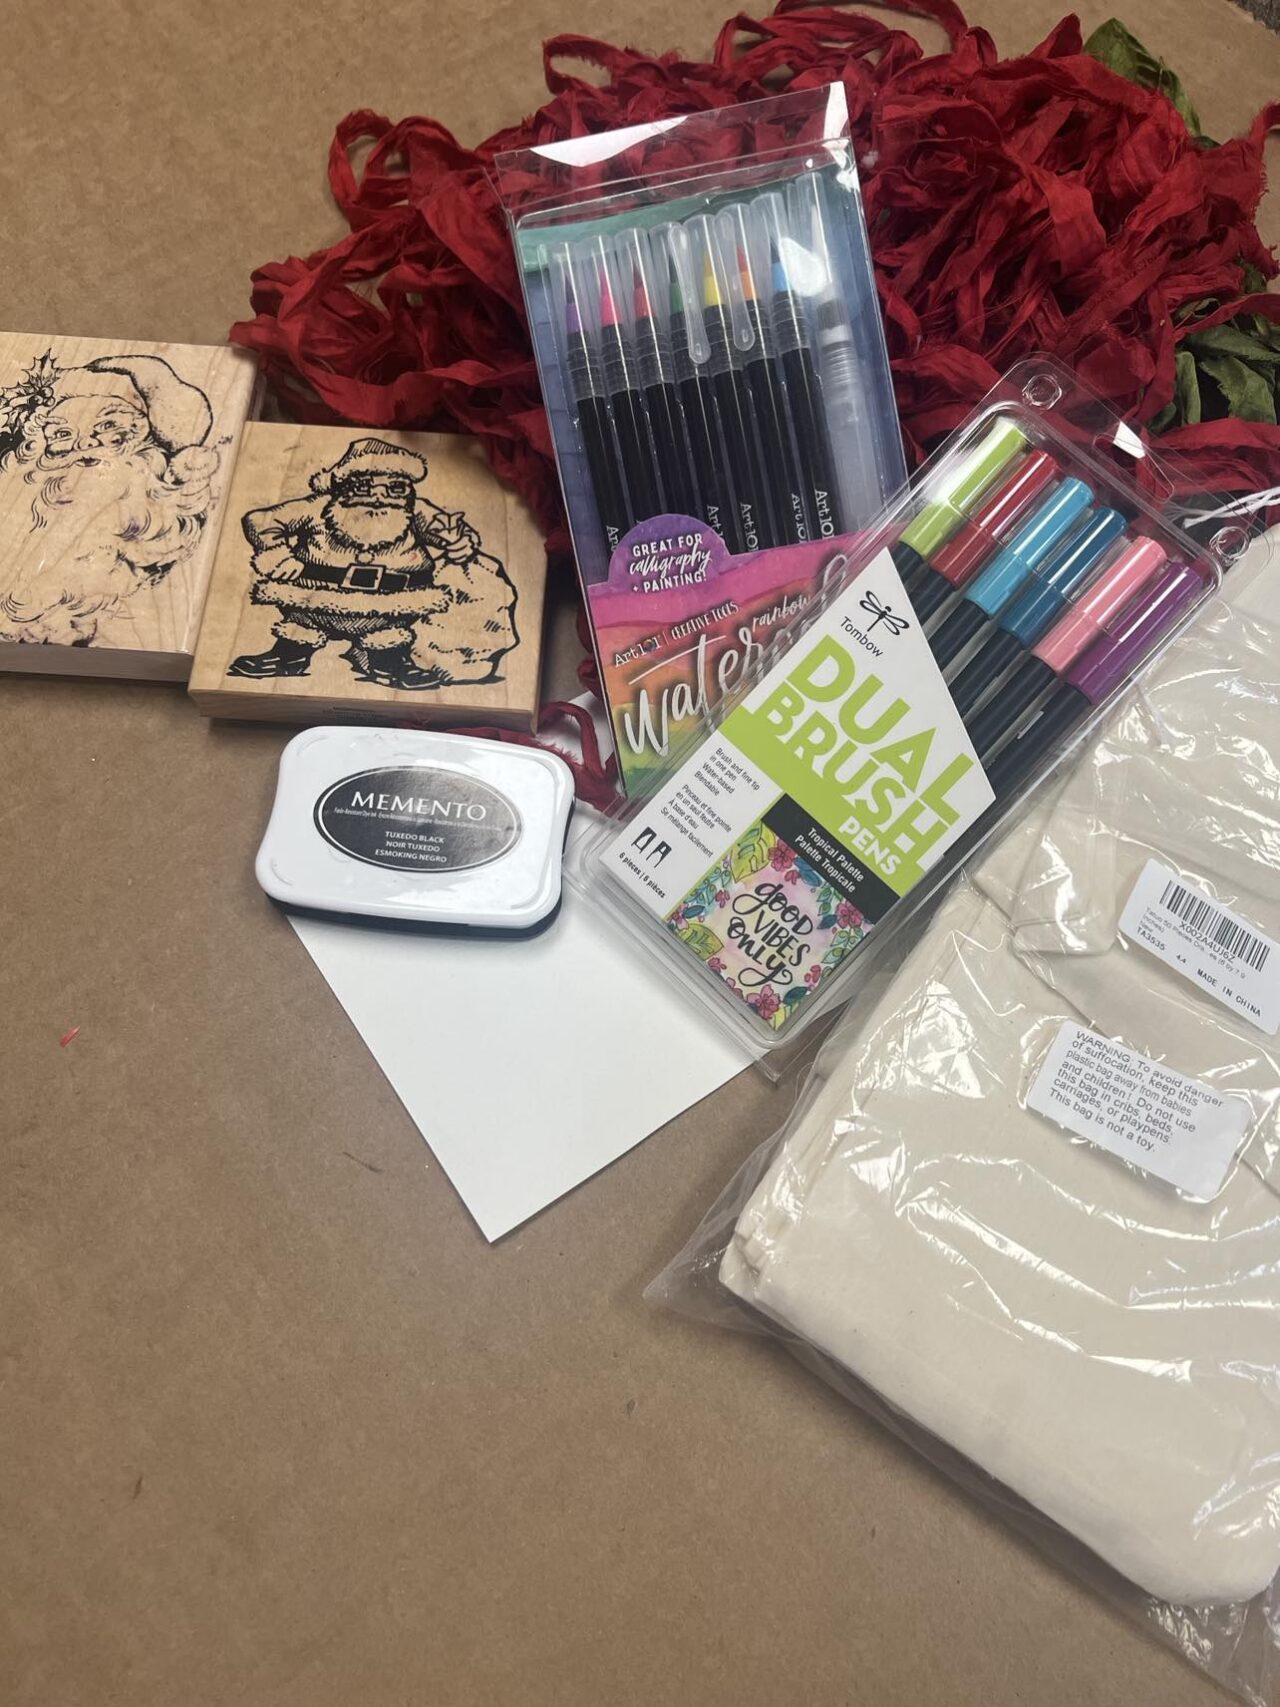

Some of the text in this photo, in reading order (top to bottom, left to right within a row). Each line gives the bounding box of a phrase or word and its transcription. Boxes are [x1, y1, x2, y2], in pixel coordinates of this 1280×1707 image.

[629, 544, 711, 578] calligraphy
[632, 532, 703, 557] GREAT FOR
[643, 571, 707, 594] PAINTING!
[671, 614, 710, 641] CREATIVE
[711, 600, 740, 622] TOOLS
[752, 595, 811, 632] rainbow
[840, 616, 884, 658] Tombow
[785, 634, 974, 827] DUAL
[694, 770, 720, 796] Blendable
[702, 762, 735, 794] Water-based
[716, 748, 760, 791] Brush and fine tip
[716, 760, 726, 772] one
[725, 769, 736, 781] pen
[752, 681, 950, 872] BRUSH
[351, 791, 487, 821] MEMENTO
[672, 804, 686, 817] base
[684, 814, 699, 830] d'eau
[676, 792, 715, 829] en un seul feutre
[682, 784, 732, 832] Pinceau et fine pointe
[385, 831, 446, 845] TUXEDO BLACK
[386, 840, 440, 853] NOIR TUXEDO
[660, 806, 669, 816] Se
[687, 832, 714, 858] facilement
[838, 816, 902, 875] PENS
[375, 849, 448, 864] ESMOKING NEGRO
[795, 834, 856, 893] Palette Tropicale
[808, 827, 864, 882] Tropical Palette
[622, 856, 642, 876] pieces
[646, 880, 666, 898] pièces
[754, 910, 810, 966] VIBES
[1179, 920, 1236, 963] X002A4UJ6Z
[1136, 926, 1166, 951] TA3535
[1197, 968, 1217, 987] MADE
[1222, 986, 1232, 997] IN
[1236, 996, 1261, 1017] CHINA
[1066, 1050, 1192, 1116] plastic bag away from babies
[1072, 1040, 1084, 1050] of
[1149, 1077, 1176, 1096] keep
[1178, 1090, 1200, 1107] this
[1138, 1060, 1150, 1073] To
[1152, 1069, 1182, 1089] avoid
[1184, 1083, 1224, 1108] danger
[1057, 1068, 1174, 1136] this bag in cribs, beds,
[1062, 1060, 1082, 1076] and
[1136, 1097, 1152, 1112] Do
[1154, 1106, 1174, 1122] not
[1175, 1117, 1196, 1132] use
[1050, 1088, 1156, 1152] This bag is not a toy.
[1106, 1106, 1120, 1118] or
[1120, 1112, 1171, 1145] playpens.
